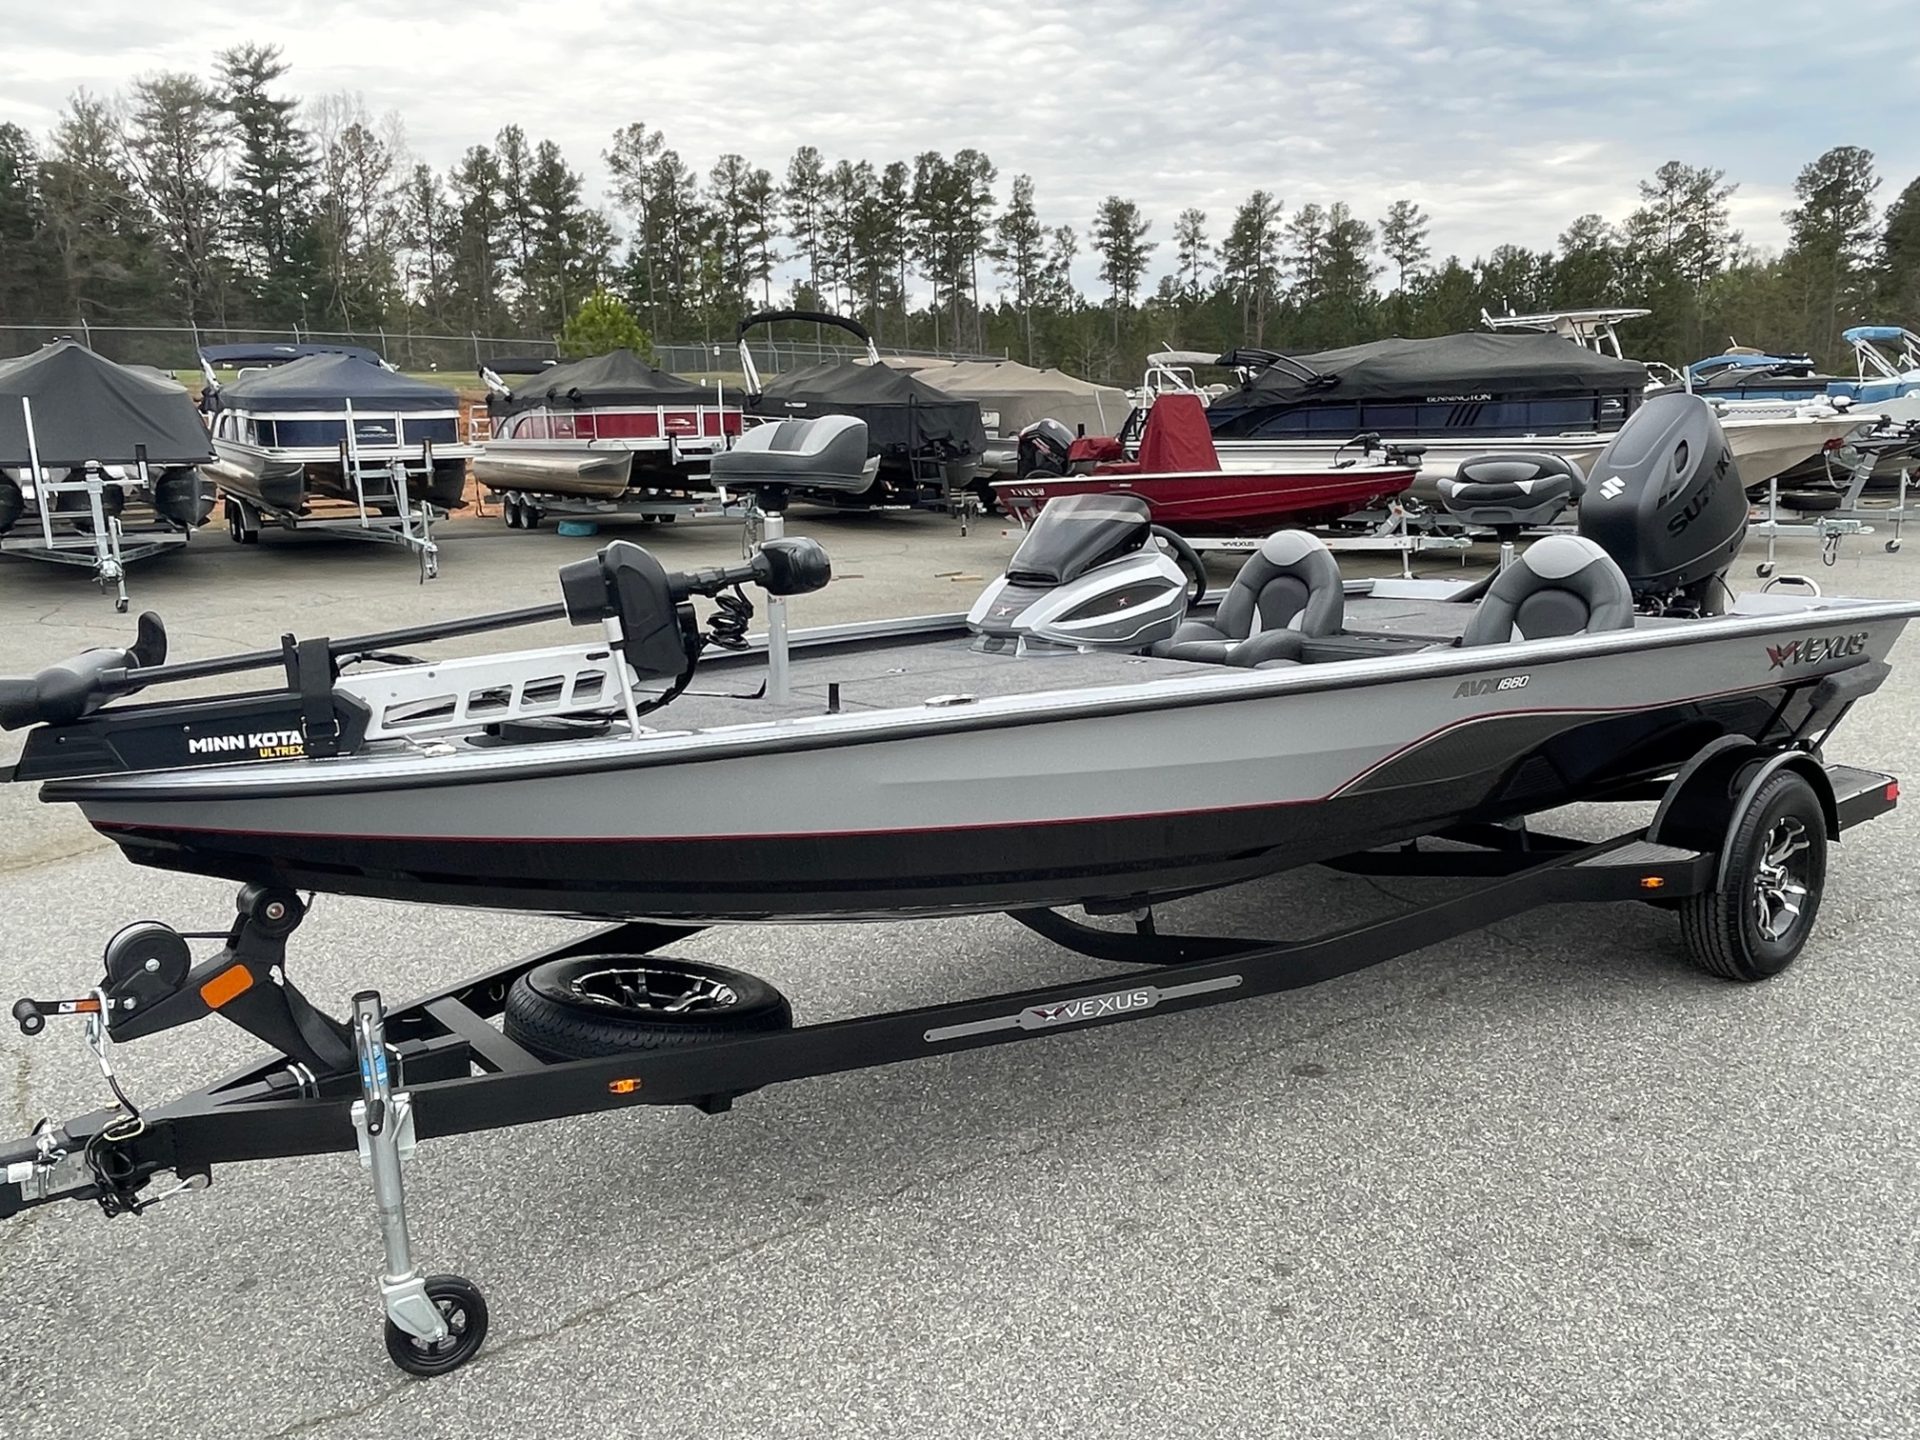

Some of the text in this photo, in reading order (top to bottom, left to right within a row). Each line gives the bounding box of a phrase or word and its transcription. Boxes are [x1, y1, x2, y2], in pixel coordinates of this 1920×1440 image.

[1666, 446, 1731, 538] SUZKI
[188, 730, 304, 754] MINN KOTA
[259, 745, 304, 758] ULTREX
[1065, 991, 1149, 1018] VEXUS
